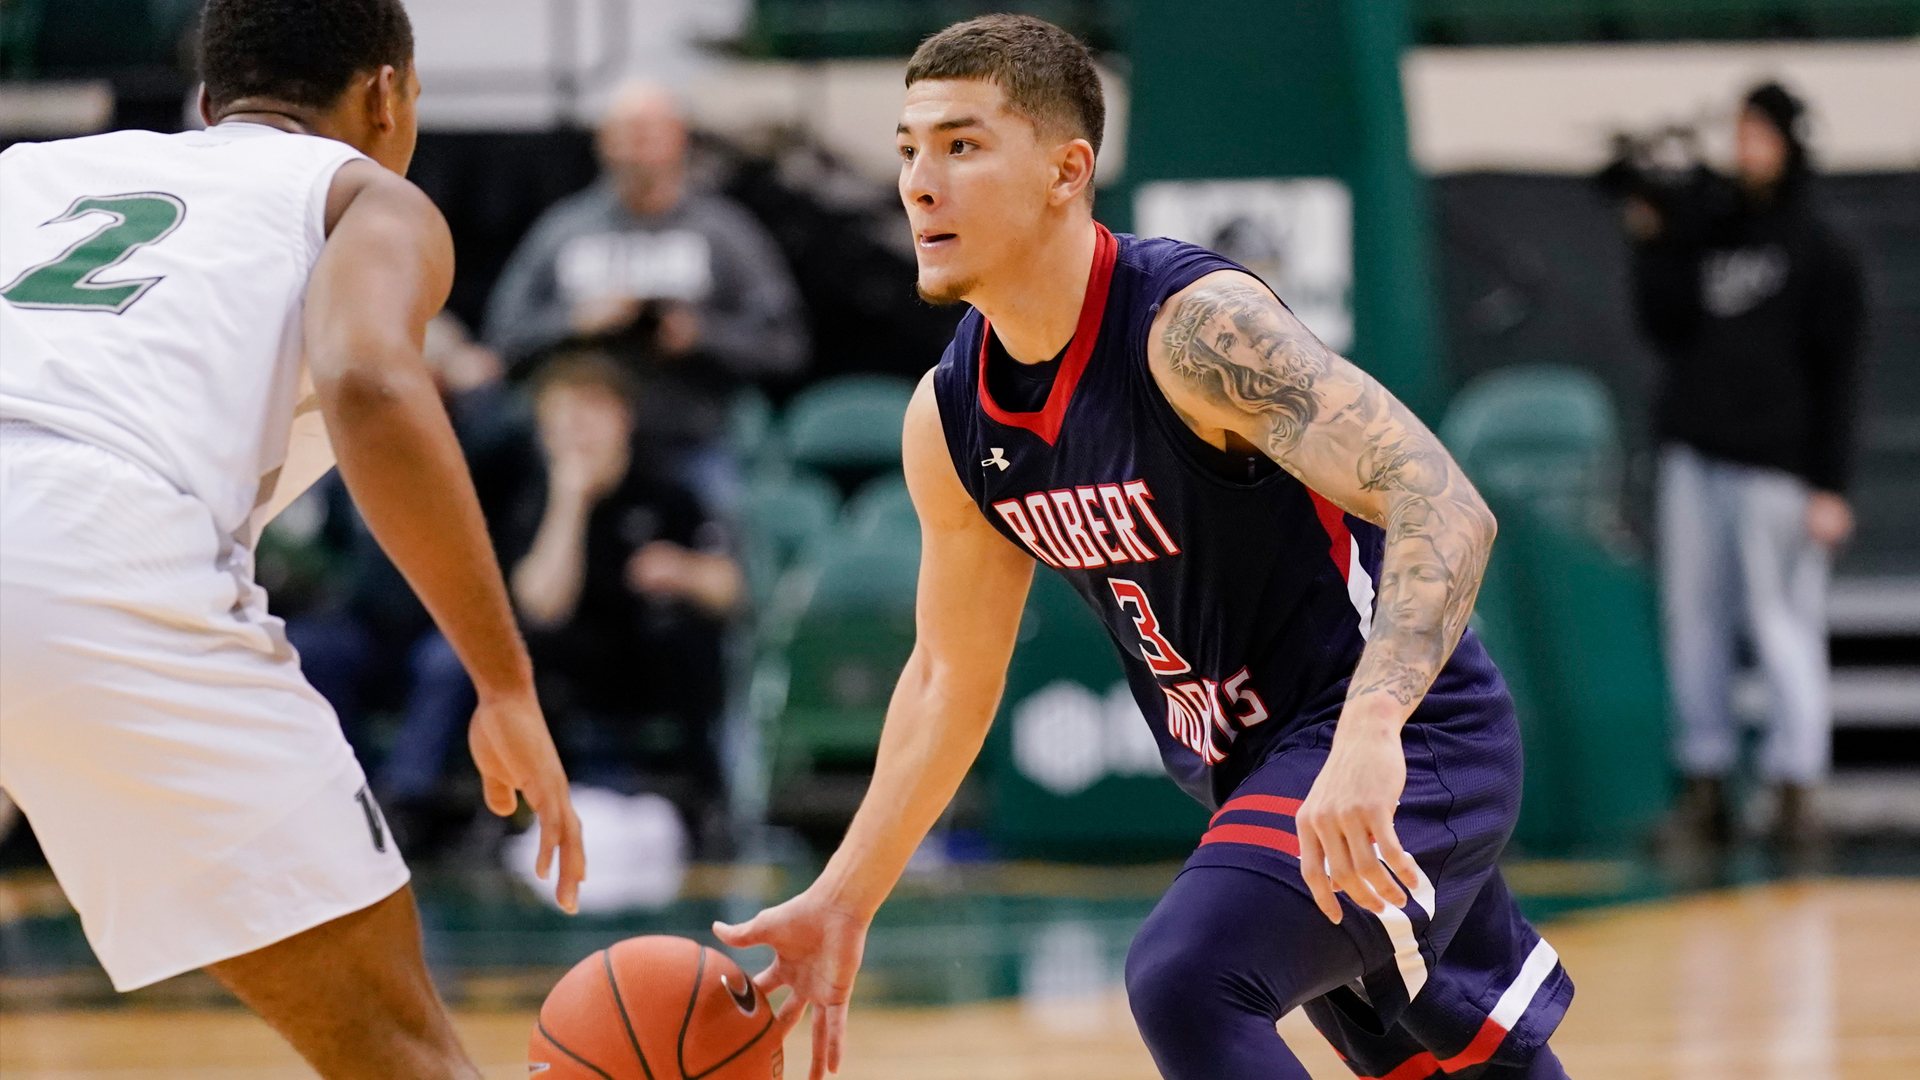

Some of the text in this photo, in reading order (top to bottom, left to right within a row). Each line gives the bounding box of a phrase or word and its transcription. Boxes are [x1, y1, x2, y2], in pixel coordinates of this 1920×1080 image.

[0, 191, 186, 315] 2
[992, 478, 1181, 569] ROBERT
[1107, 577, 1192, 678] 3
[1158, 664, 1270, 766] MORIS
